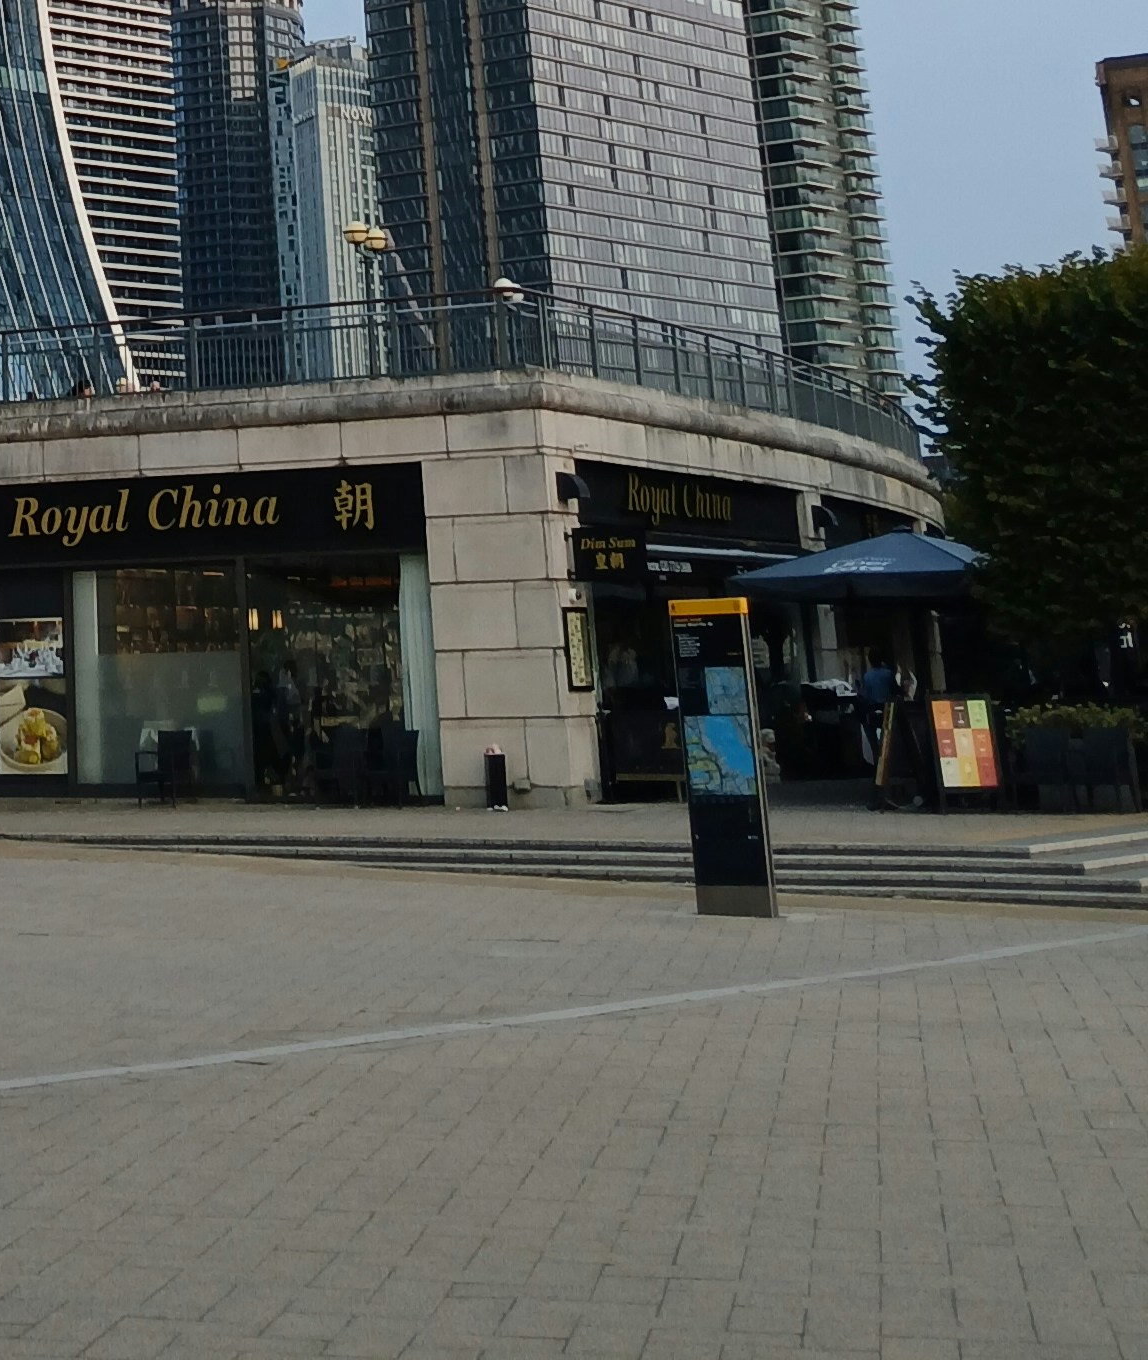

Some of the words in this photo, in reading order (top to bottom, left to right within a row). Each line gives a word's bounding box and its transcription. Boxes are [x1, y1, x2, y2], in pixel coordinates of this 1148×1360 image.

[8, 488, 130, 547] Royal
[148, 484, 280, 531] China
[334, 480, 375, 531] 朝
[628, 472, 677, 525] Royal
[683, 482, 732, 521] China
[580, 537, 606, 550] Dim
[608, 536, 636, 549] Sum
